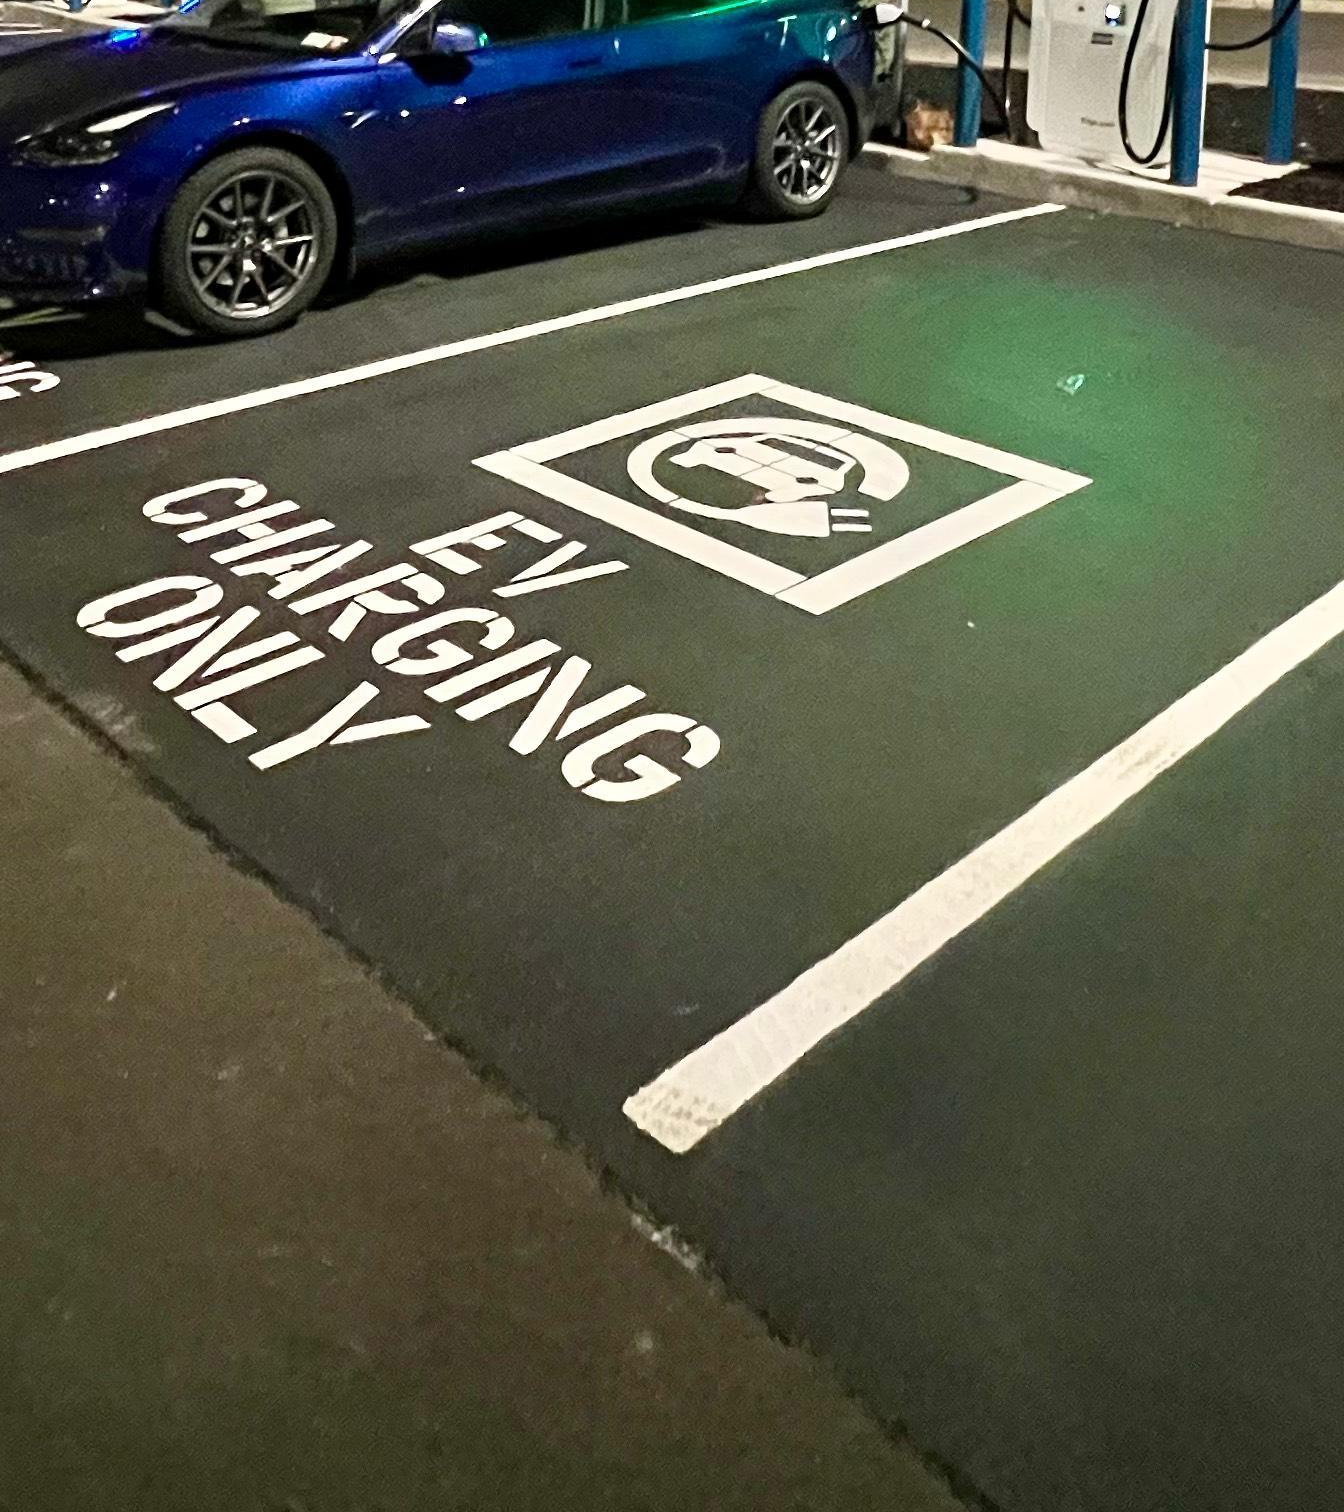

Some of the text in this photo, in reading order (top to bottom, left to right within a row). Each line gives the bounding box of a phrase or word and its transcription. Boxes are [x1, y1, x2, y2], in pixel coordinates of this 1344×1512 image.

[142, 476, 722, 803] CHARGING
[408, 510, 630, 599] EV
[75, 574, 431, 771] ONLY
